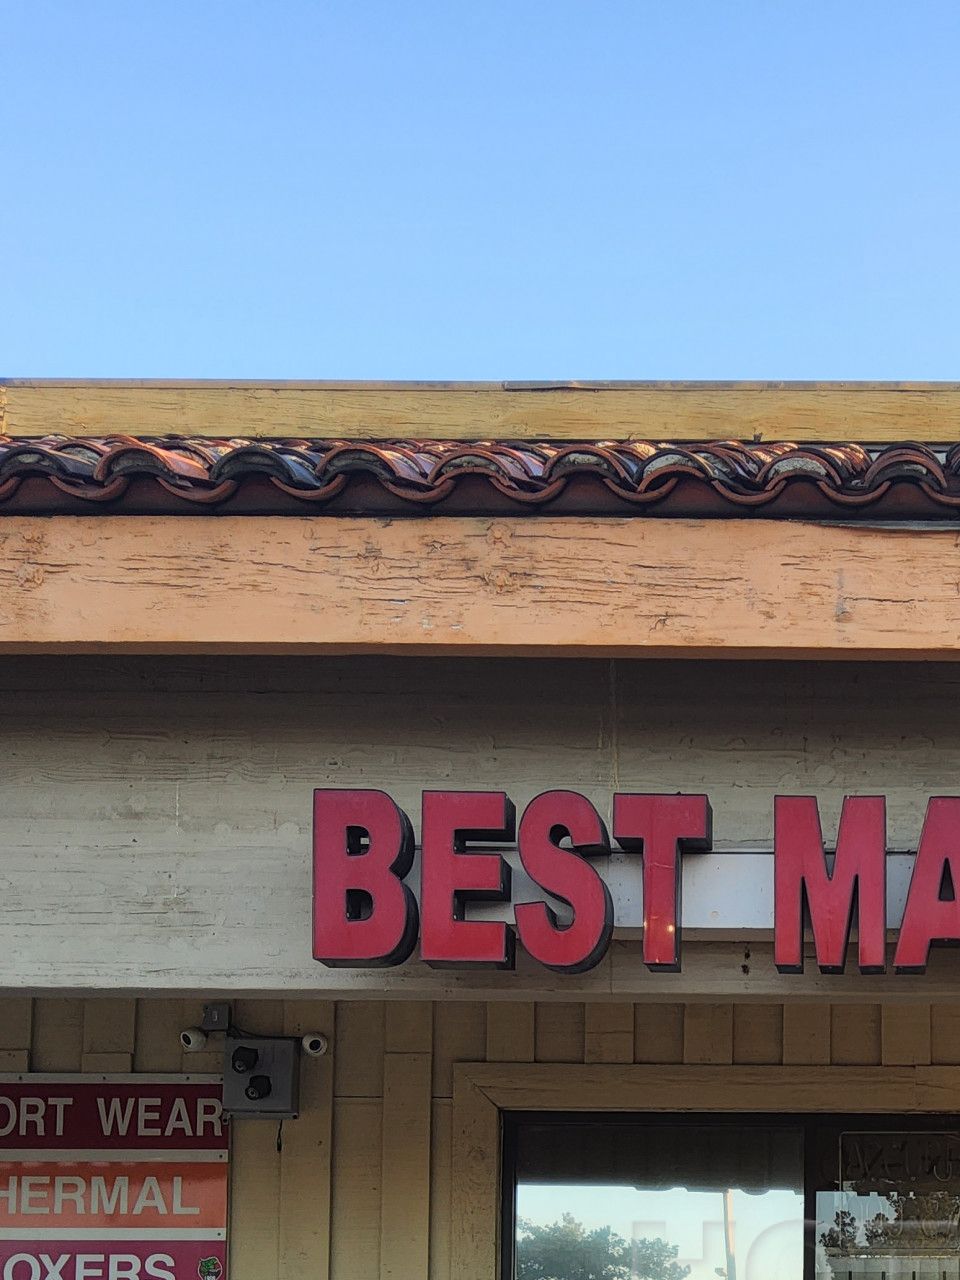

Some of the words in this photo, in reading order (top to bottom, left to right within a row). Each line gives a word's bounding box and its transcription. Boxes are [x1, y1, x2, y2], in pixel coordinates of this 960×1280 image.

[312, 788, 711, 973] BEST
[97, 1097, 223, 1137] WEAR
[0, 1176, 200, 1215] HERMAL
